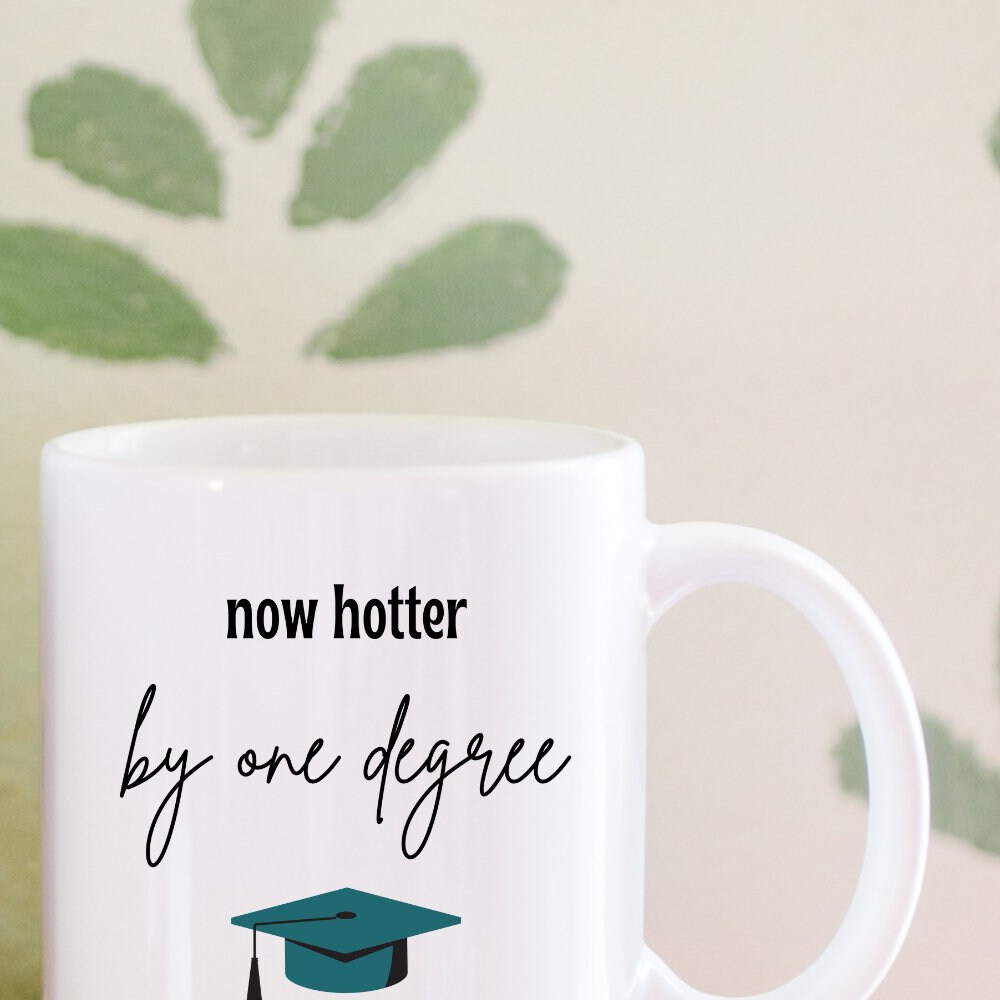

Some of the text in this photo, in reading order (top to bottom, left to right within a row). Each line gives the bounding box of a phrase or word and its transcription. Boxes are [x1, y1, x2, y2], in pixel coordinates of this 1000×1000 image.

[226, 583, 468, 640] now hotter
[119, 683, 572, 868] by one degree
